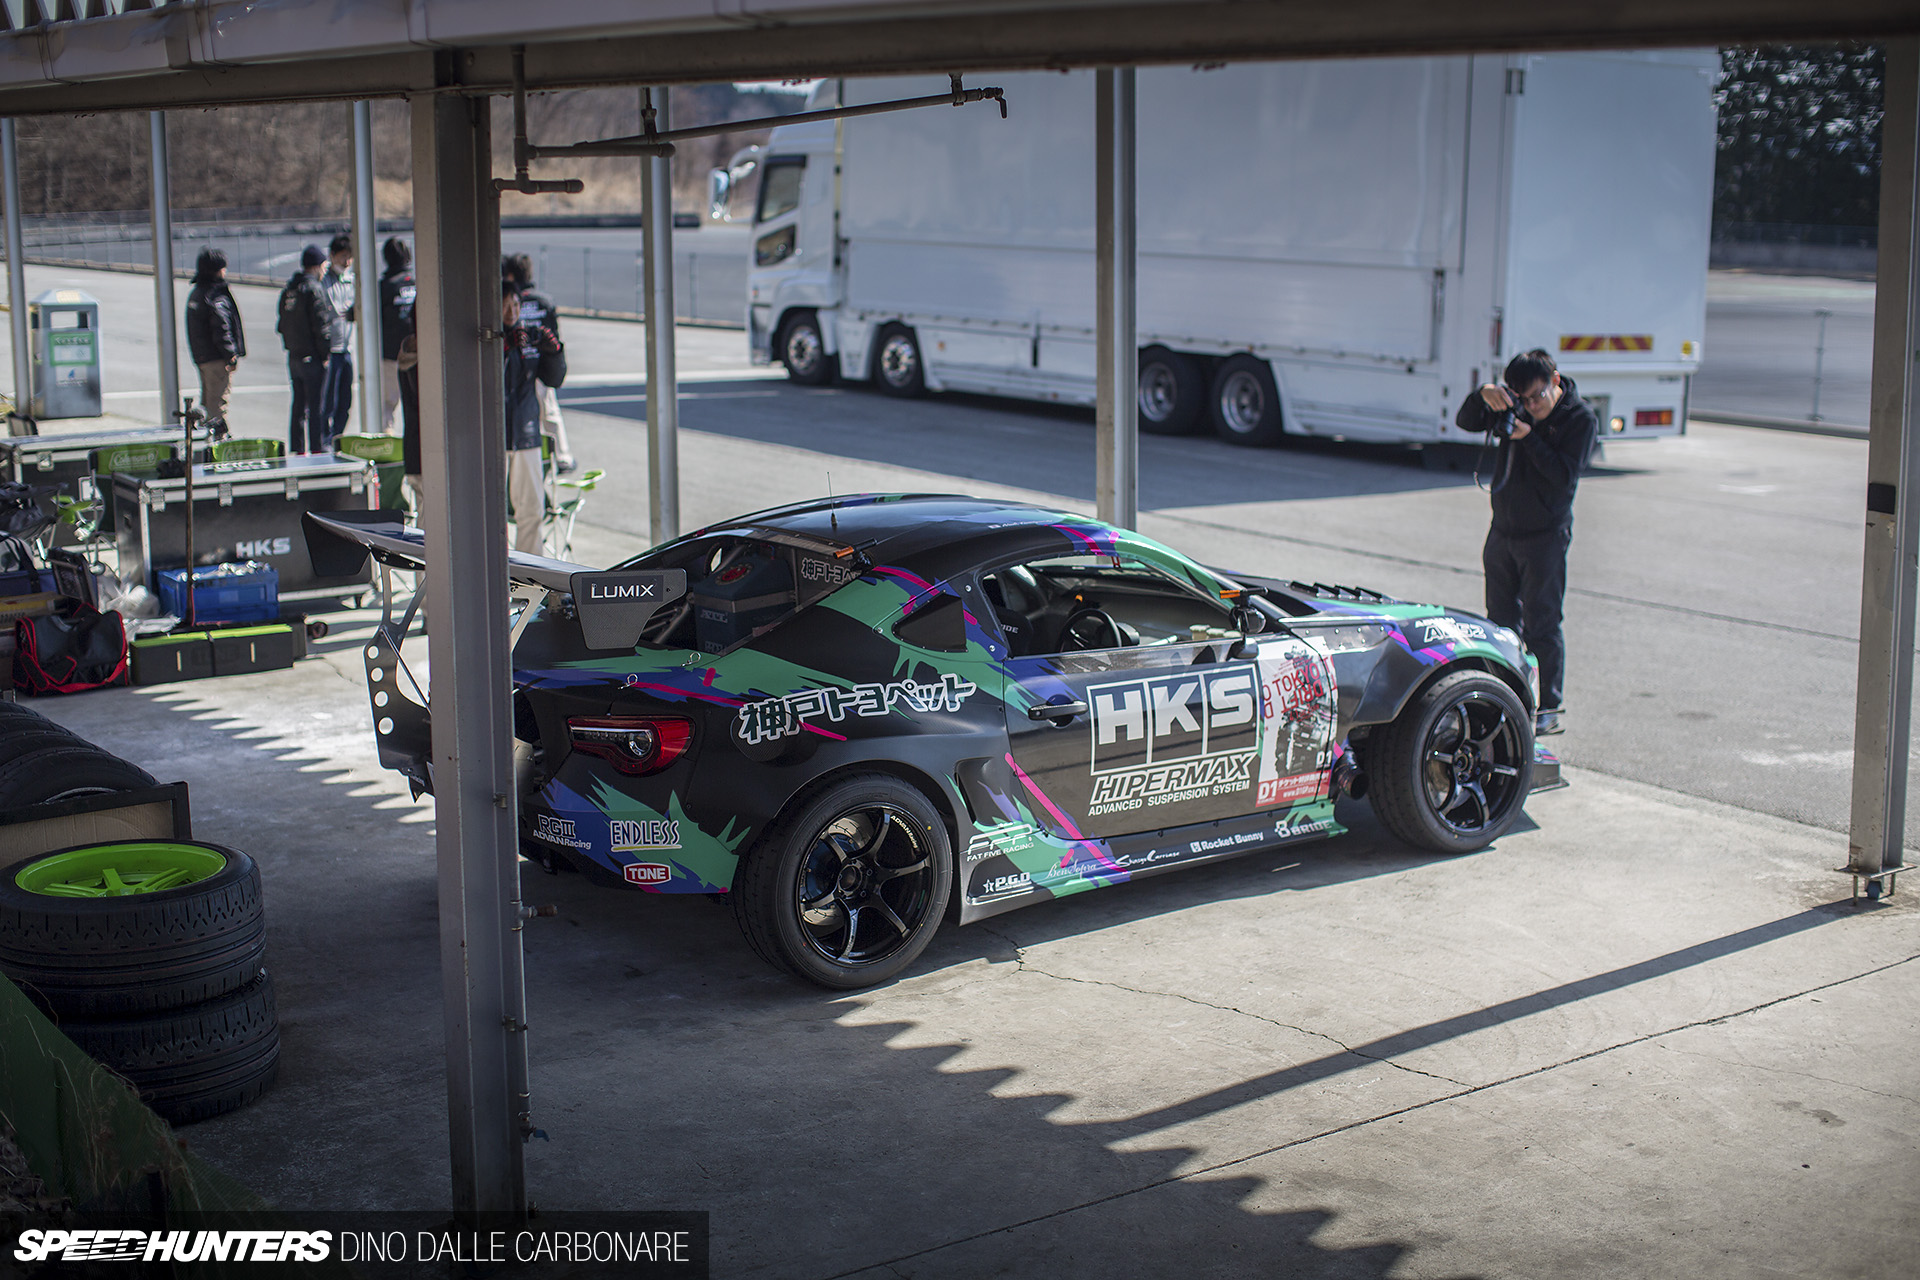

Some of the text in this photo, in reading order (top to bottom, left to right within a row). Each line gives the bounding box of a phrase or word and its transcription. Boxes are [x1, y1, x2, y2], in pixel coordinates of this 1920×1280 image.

[235, 537, 291, 560] HKS
[591, 583, 654, 599] LUMIX
[1272, 663, 1320, 697] TOKYO
[738, 673, 977, 744] 神戸トヨペット
[1095, 675, 1254, 745] HKS
[1090, 752, 1258, 805] HIPERMAX
[1088, 780, 1250, 816] ADVANCED SUSPENSION SYSTEM
[1258, 781, 1278, 800] D1
[610, 820, 680, 846] ENDLESS
[1290, 820, 1333, 836] BRIDE
[966, 842, 1035, 862] FAT FIVE RACING
[1201, 831, 1264, 851] Rocket Bunny
[628, 867, 667, 880] TONE
